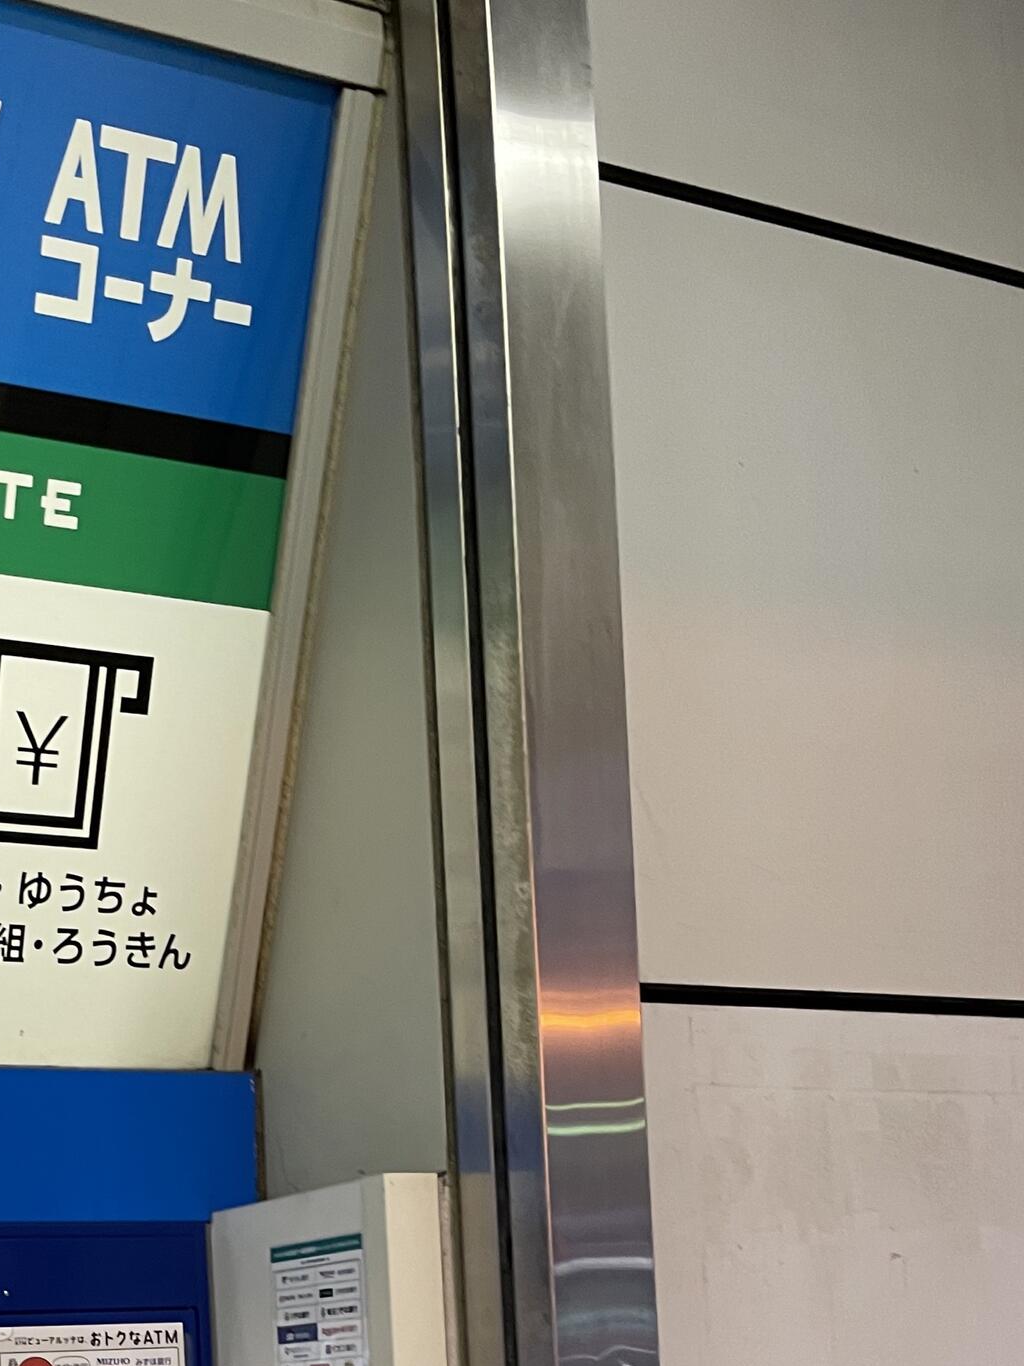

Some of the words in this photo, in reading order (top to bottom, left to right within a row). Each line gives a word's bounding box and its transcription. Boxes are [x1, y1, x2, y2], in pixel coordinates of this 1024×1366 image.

[43, 118, 243, 263] ATM
[33, 235, 252, 342] コーナー
